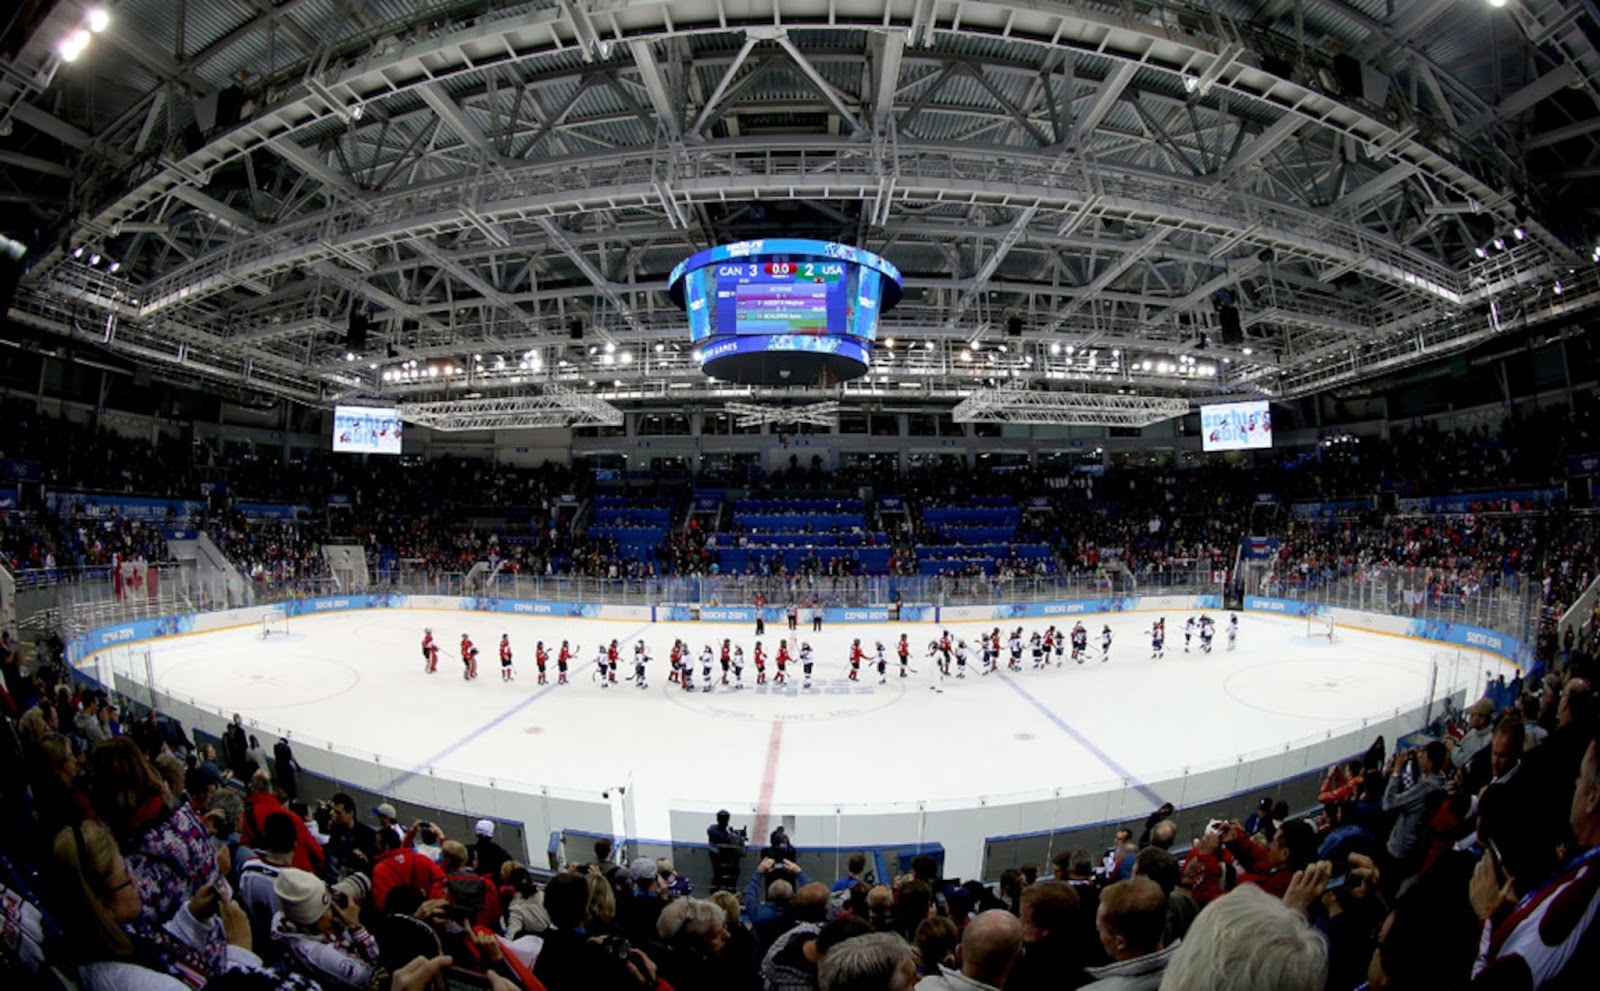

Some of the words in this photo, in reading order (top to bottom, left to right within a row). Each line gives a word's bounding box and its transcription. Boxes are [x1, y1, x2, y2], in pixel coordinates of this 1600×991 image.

[719, 266, 743, 276] CAN
[749, 264, 758, 277] 3
[804, 263, 815, 277] 2
[822, 265, 844, 275] USA
[701, 611, 727, 620] SOCHI
[728, 611, 748, 620] 2014
[844, 611, 868, 620] СОЧИ
